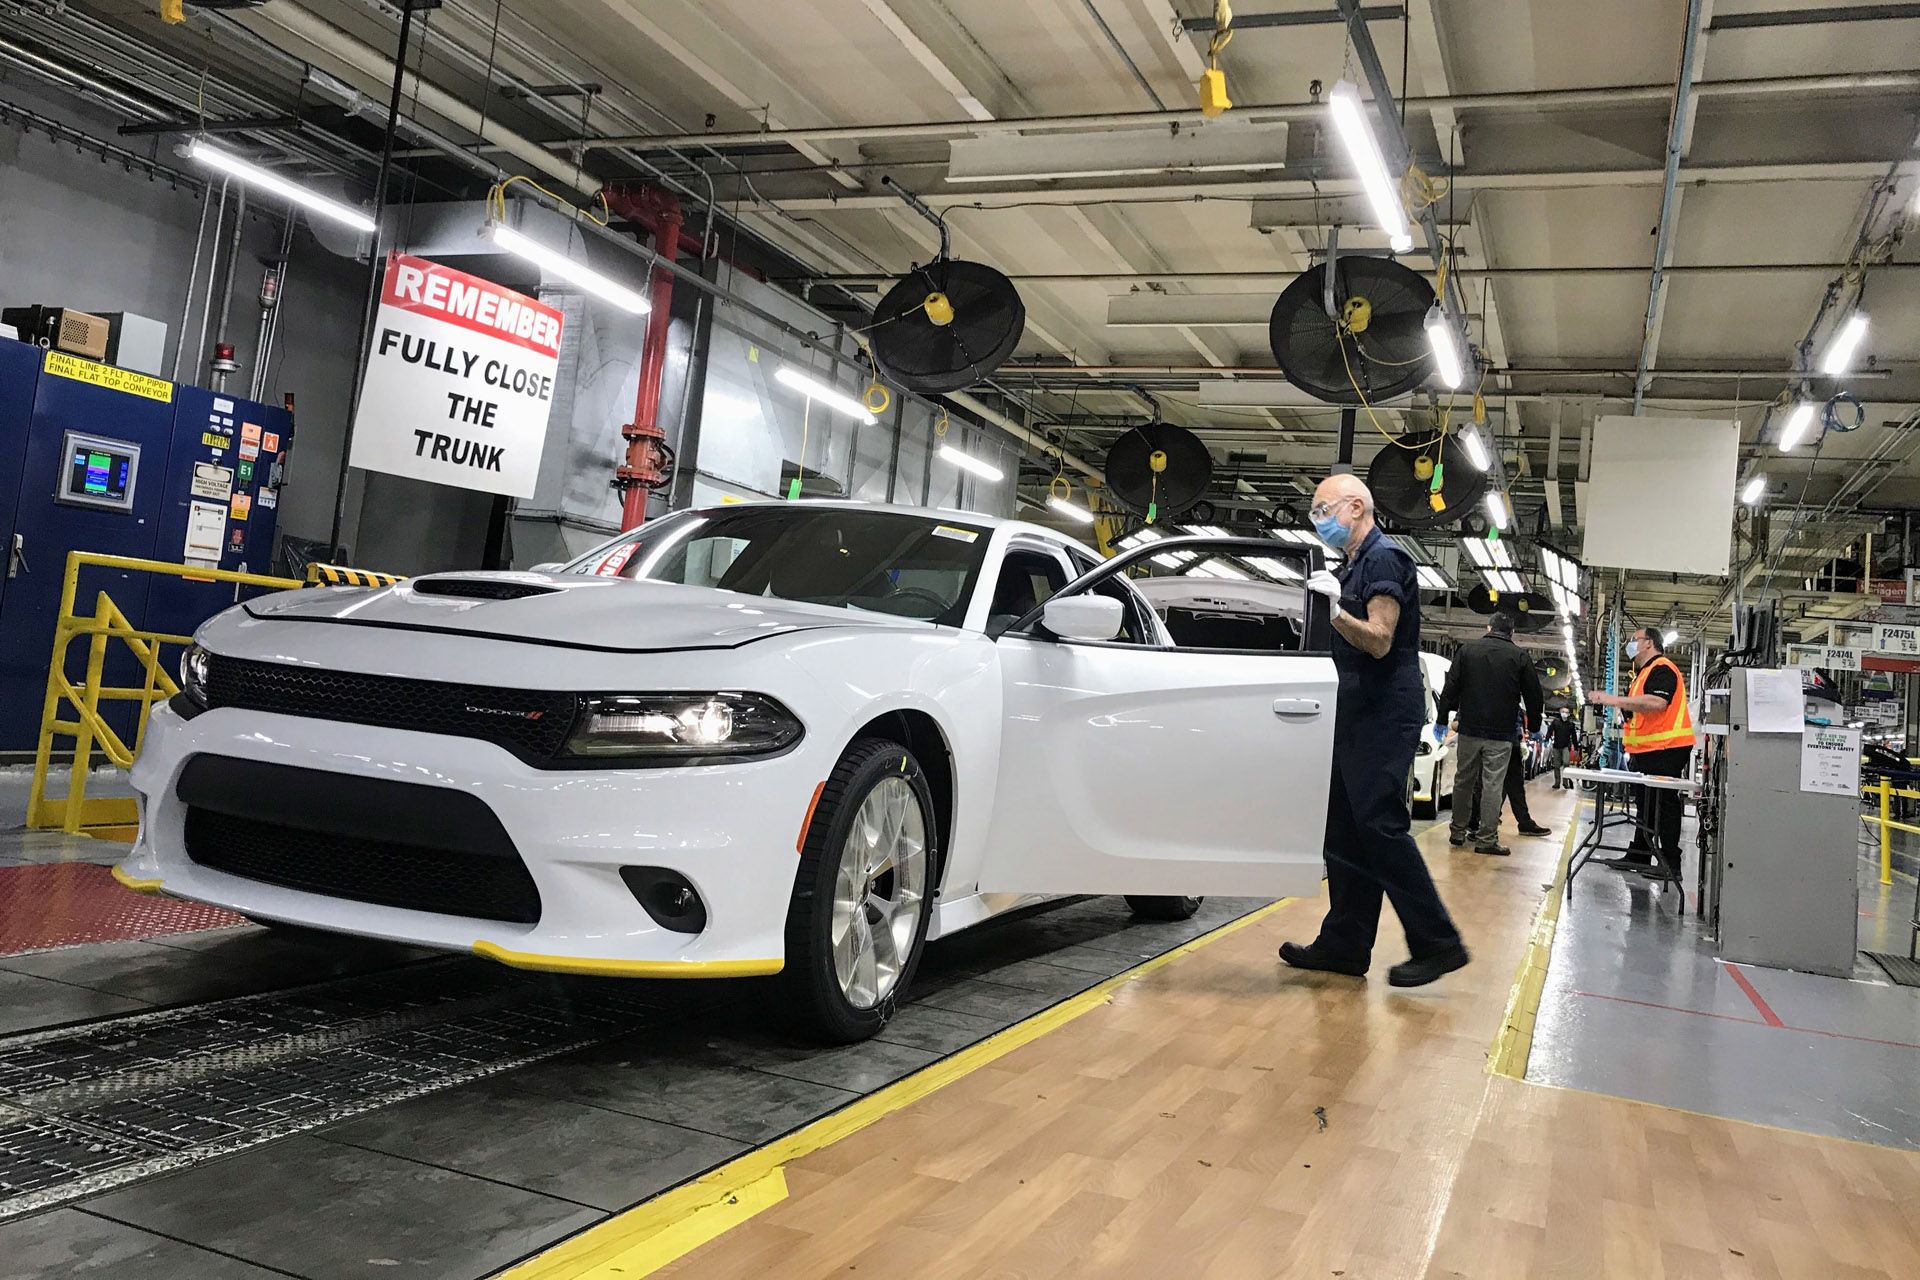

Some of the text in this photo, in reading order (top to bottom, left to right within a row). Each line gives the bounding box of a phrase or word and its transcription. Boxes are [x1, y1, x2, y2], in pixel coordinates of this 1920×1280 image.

[395, 264, 560, 350] REMEMBER
[49, 363, 169, 399] FINAL FLAT TOP CONVEYOR
[50, 353, 77, 367] FINAL
[80, 363, 99, 372] LINE
[102, 367, 108, 375] 2
[110, 369, 124, 379] FLT
[128, 373, 145, 383] TOP
[378, 328, 552, 401] FULLY CLOSE
[447, 392, 498, 428] THE
[414, 429, 506, 472] TRUNK
[208, 480, 229, 489] VOLTAGE
[240, 464, 252, 476] E1
[1882, 628, 1916, 640] F2475L
[1827, 649, 1853, 659] F2474L
